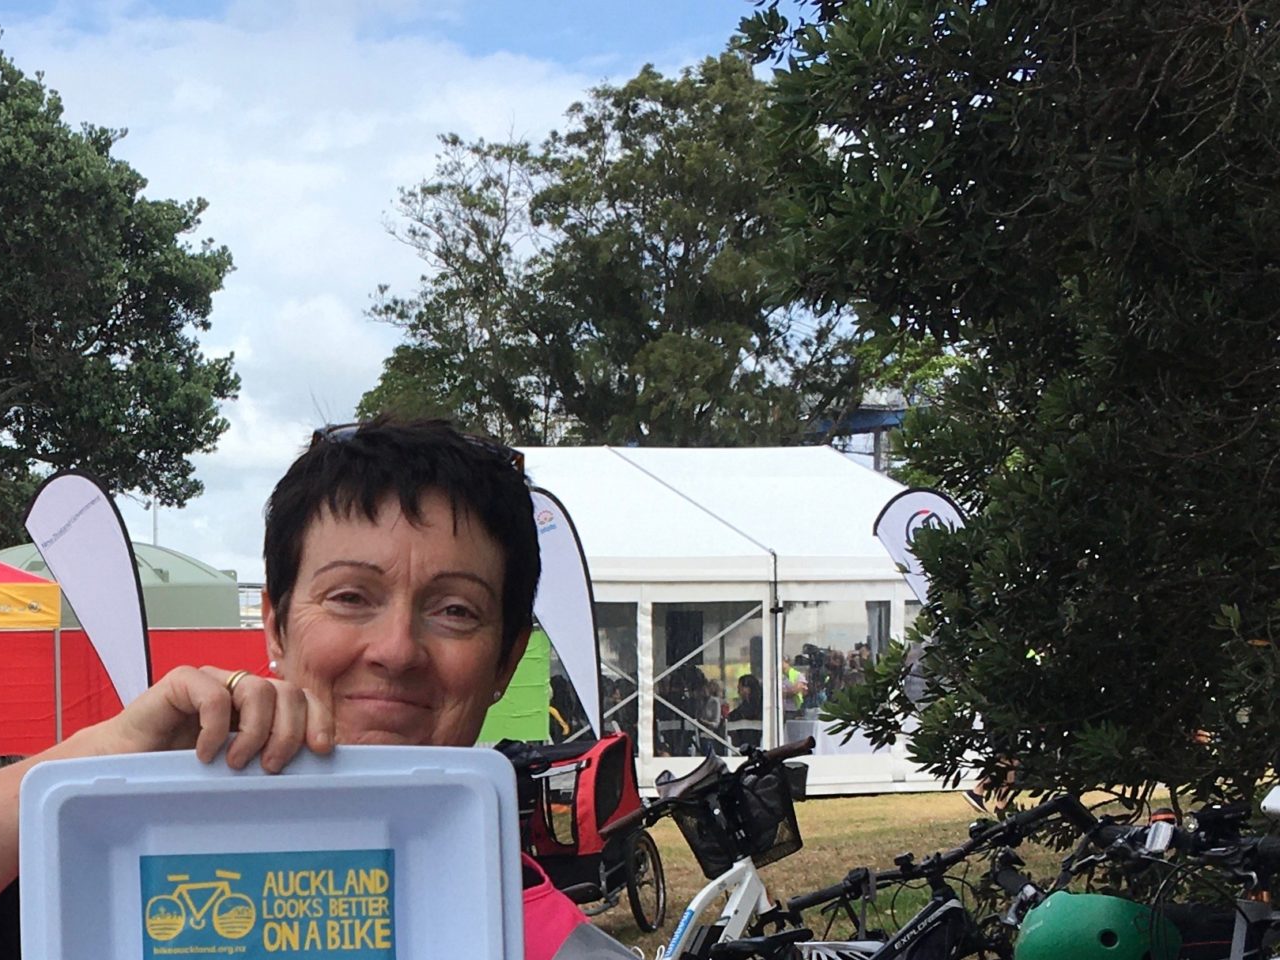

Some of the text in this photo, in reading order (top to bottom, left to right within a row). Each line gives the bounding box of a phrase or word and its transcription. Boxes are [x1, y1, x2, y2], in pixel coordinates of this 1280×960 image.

[262, 868, 389, 897] AUCKLAND
[262, 896, 390, 918] LOOKS BETTER
[263, 918, 392, 952] ON A BIKE
